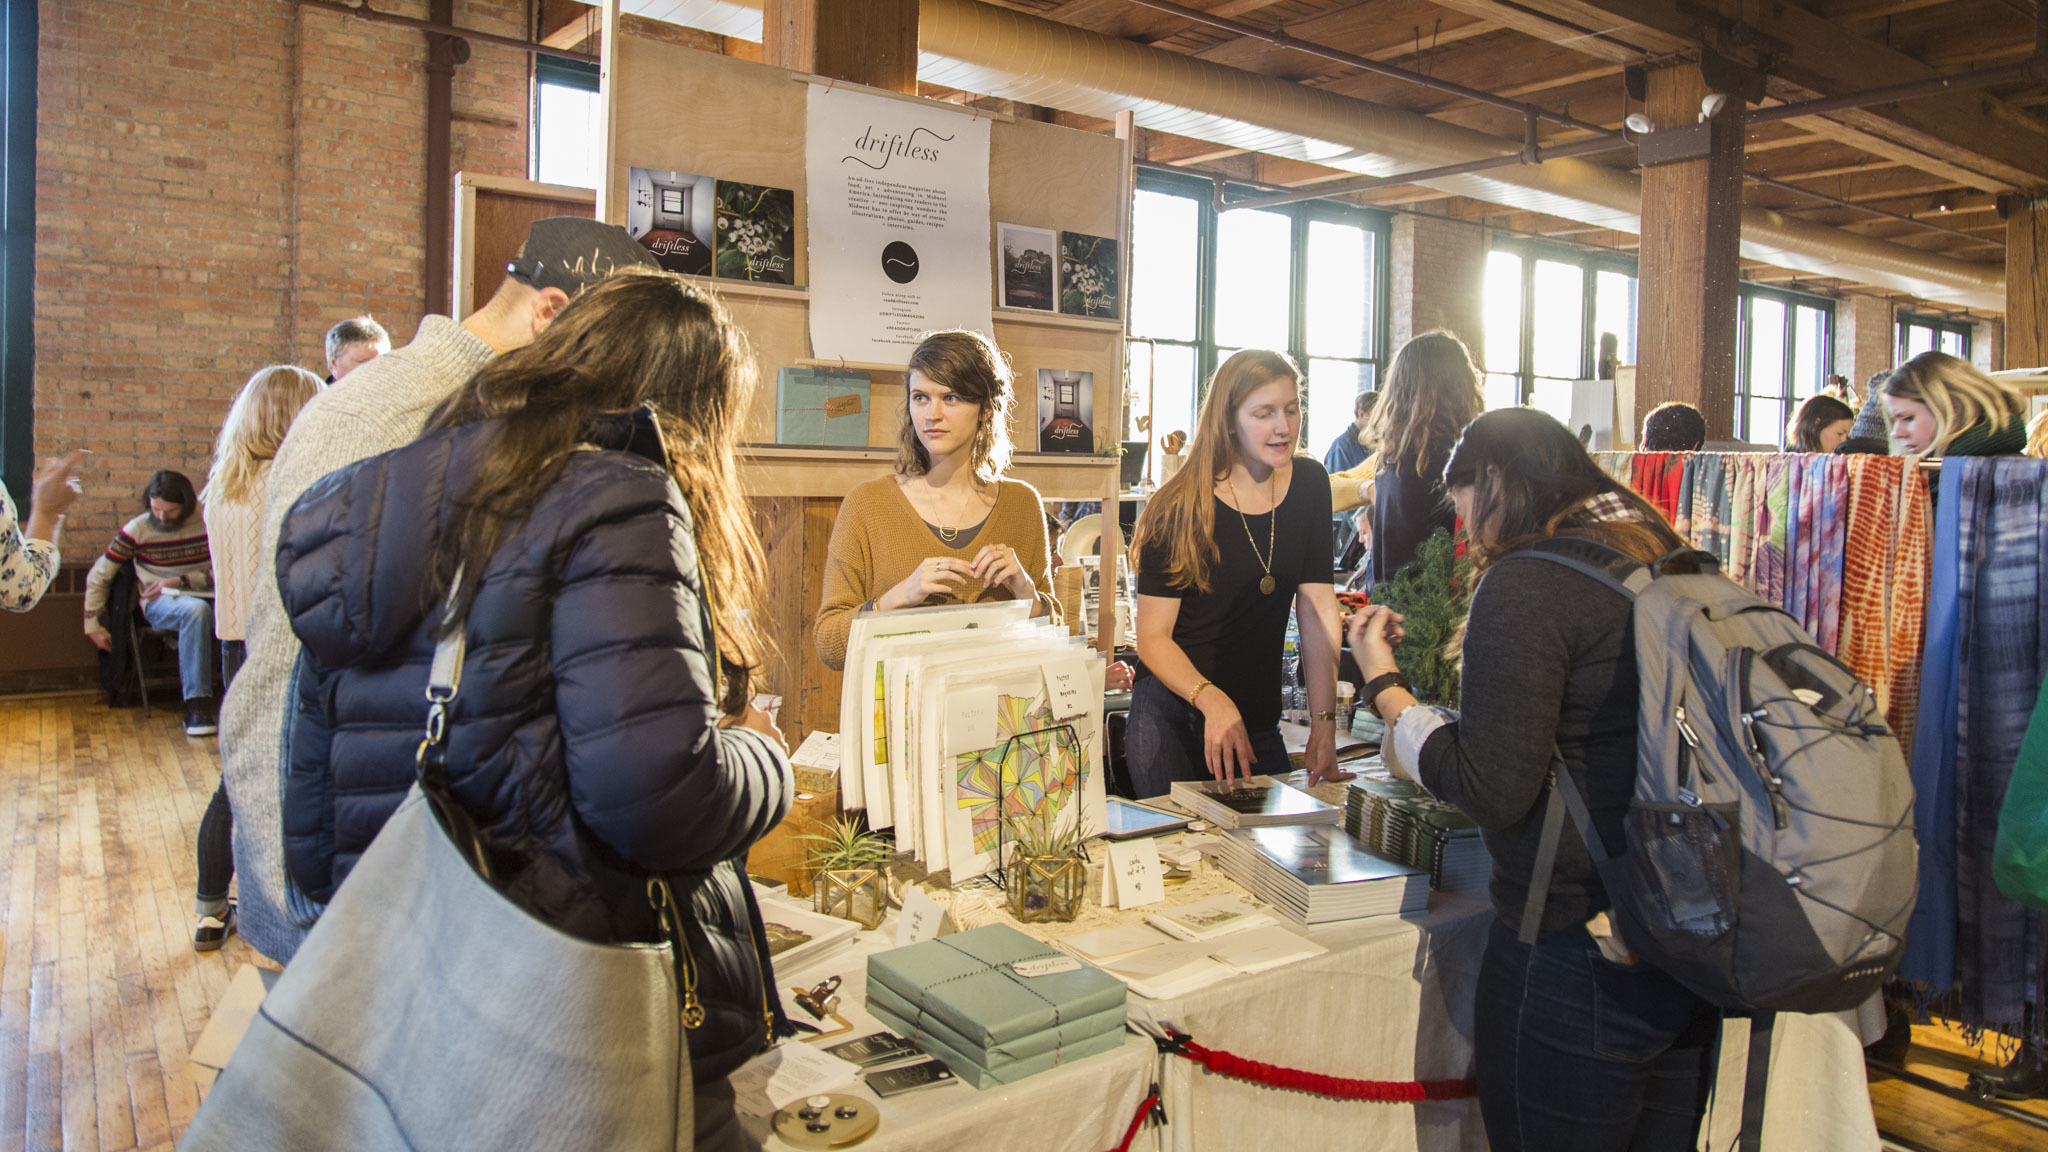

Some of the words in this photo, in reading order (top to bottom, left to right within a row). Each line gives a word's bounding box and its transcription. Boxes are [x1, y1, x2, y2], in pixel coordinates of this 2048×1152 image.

[842, 126, 955, 170] driftless
[876, 180, 906, 188] independent
[873, 193, 903, 202] Introducing
[852, 210, 886, 220] illustrations,
[648, 238, 696, 256] driftless
[745, 256, 790, 272] driftless
[1011, 258, 1046, 274] driftless
[1084, 294, 1116, 310] driftless
[1051, 423, 1084, 440] driftless
